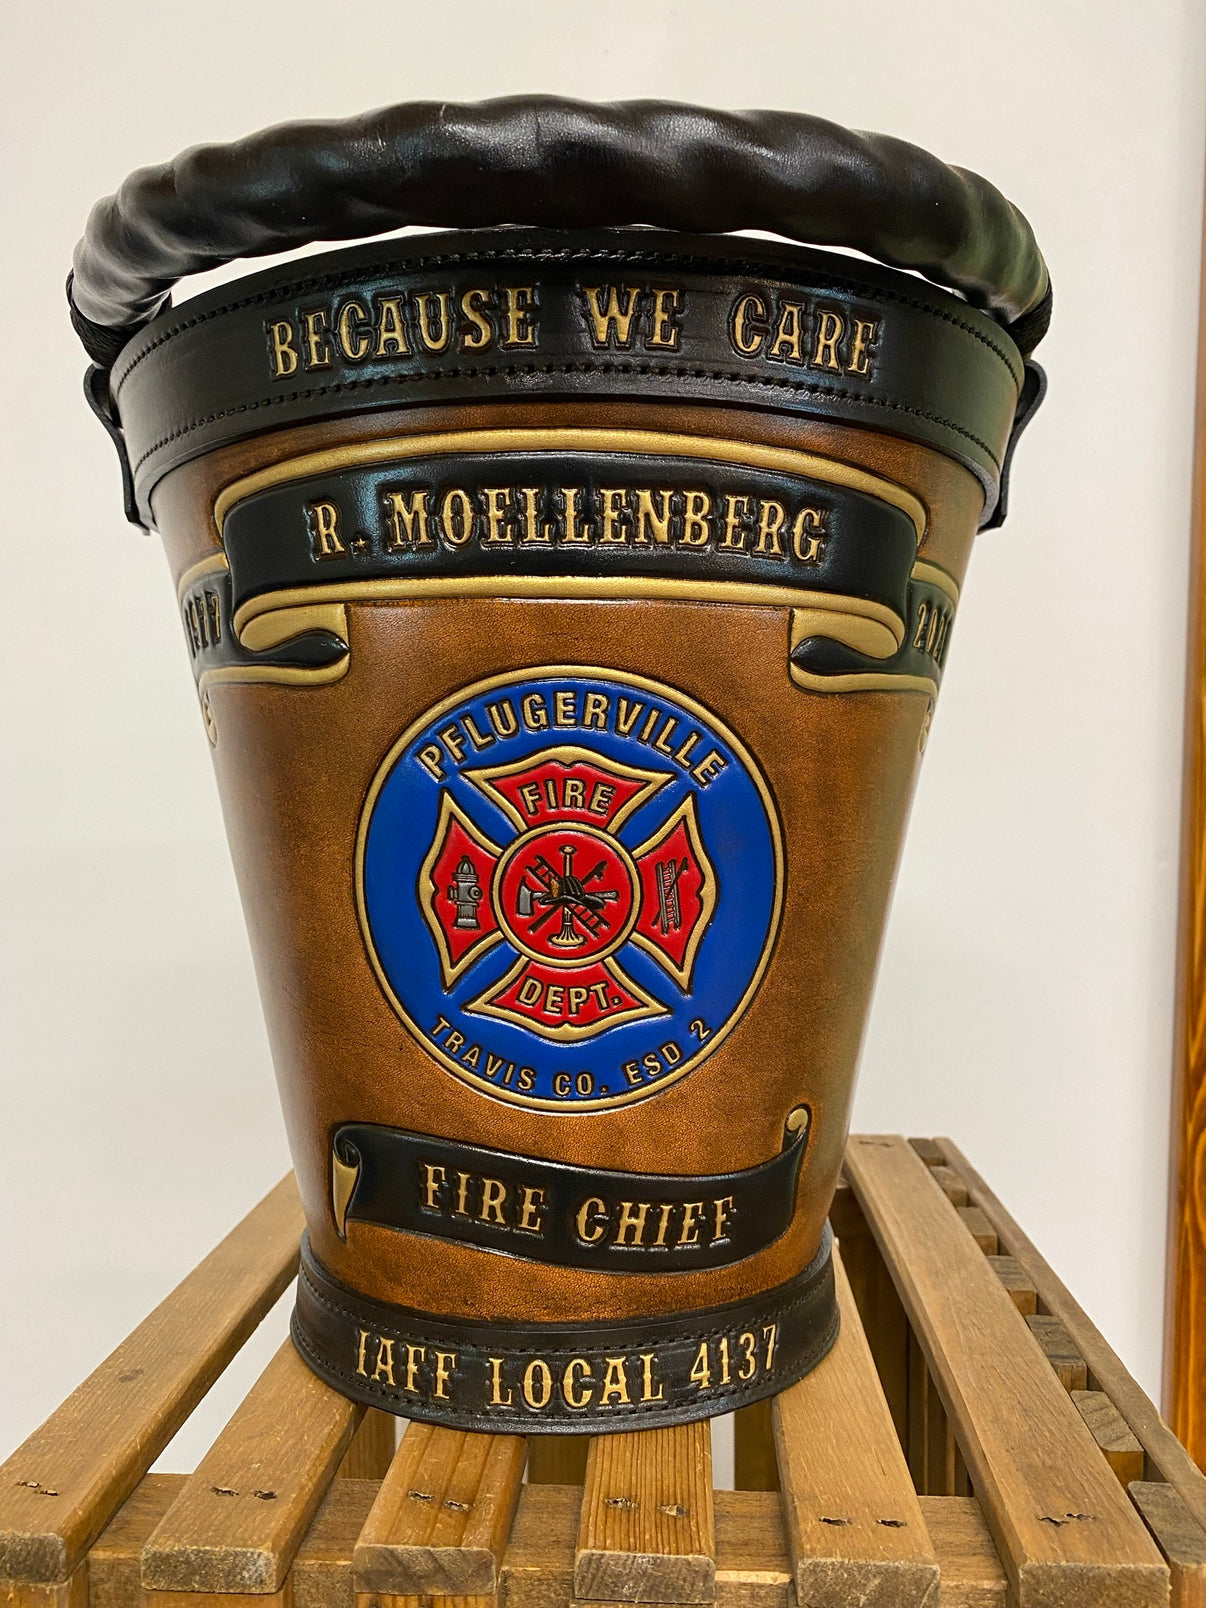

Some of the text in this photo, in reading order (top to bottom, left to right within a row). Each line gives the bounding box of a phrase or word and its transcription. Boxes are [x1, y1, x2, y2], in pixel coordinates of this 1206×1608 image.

[268, 286, 878, 379] BECAUSE WE CARE
[389, 488, 827, 562] MOELLENBERG
[913, 602, 951, 666] 202
[416, 691, 729, 788] PFLUGERVILLE
[518, 779, 616, 815] FIRE
[519, 980, 620, 1014] DEPT.
[430, 1017, 712, 1096] TRAVIS CO. ESD 2
[421, 1164, 736, 1246] FIRE CHIEF
[356, 1324, 778, 1408] IAFF LOCAL 4137
